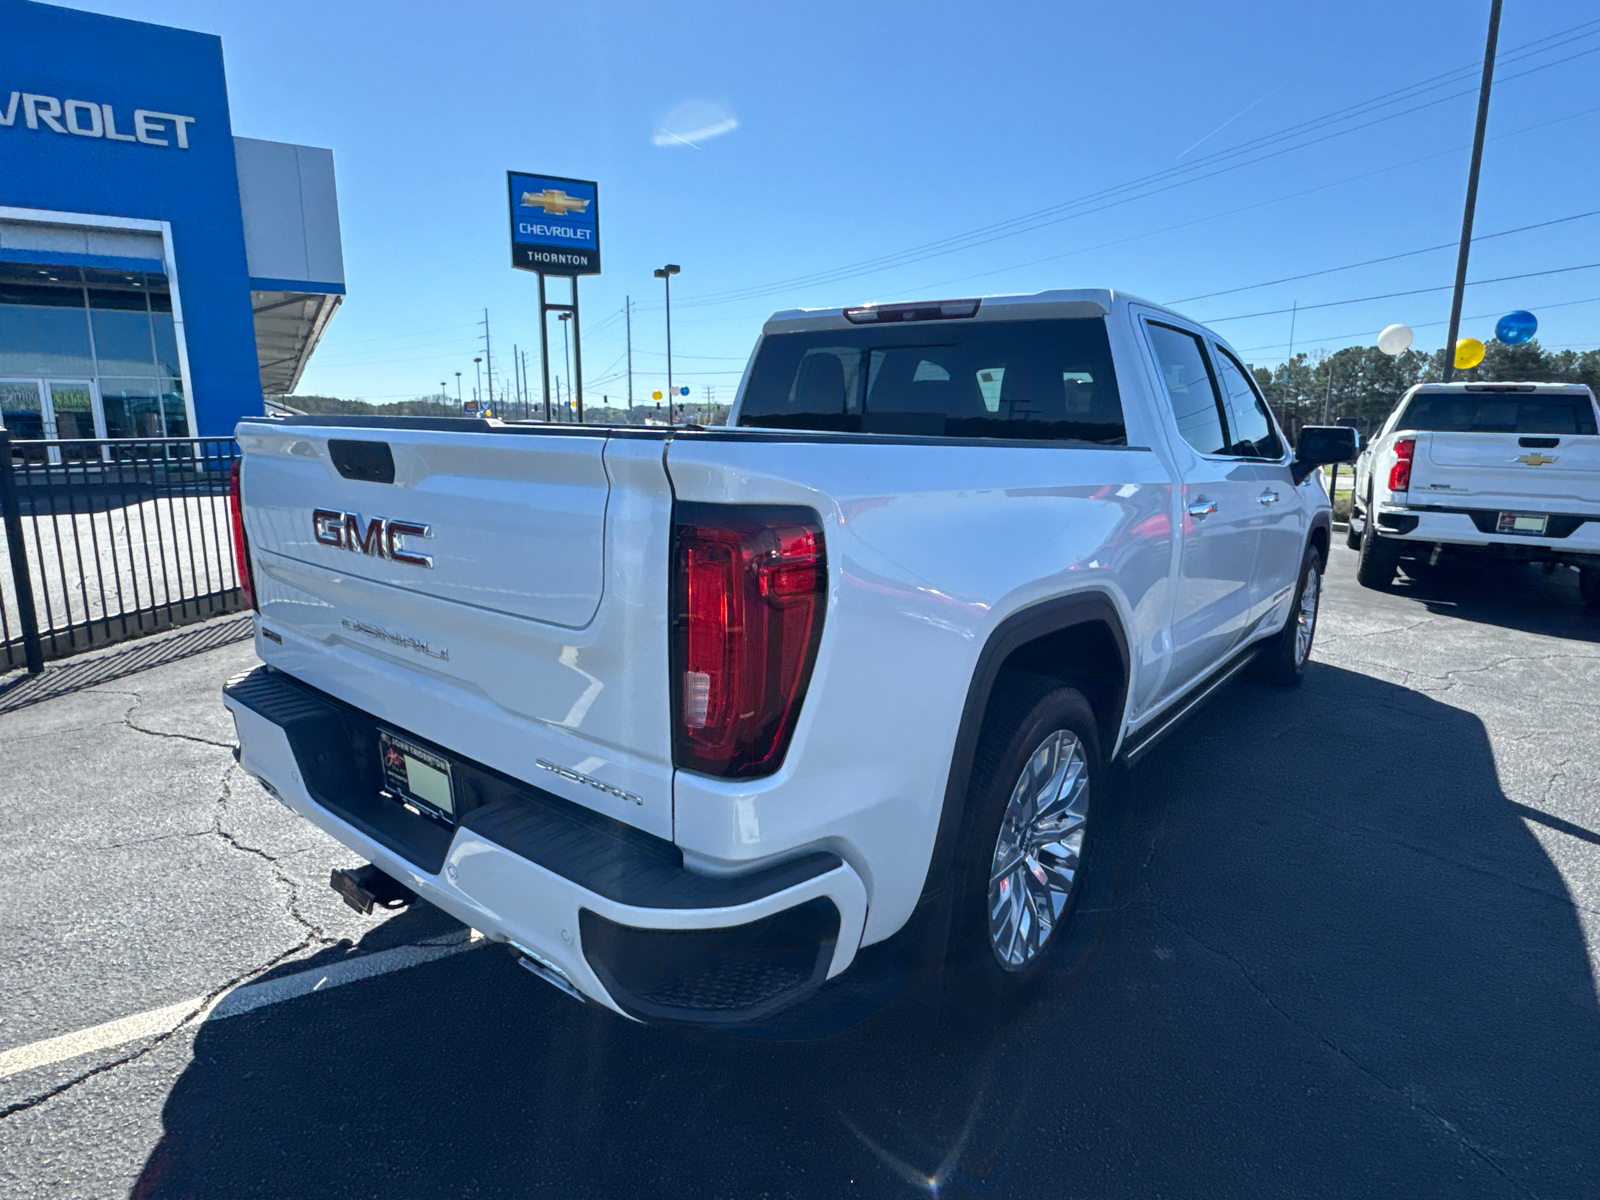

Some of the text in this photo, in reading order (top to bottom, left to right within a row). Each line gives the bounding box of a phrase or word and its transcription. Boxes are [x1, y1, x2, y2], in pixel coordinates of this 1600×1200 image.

[519, 222, 592, 239] CHEVROLET
[527, 251, 588, 265] THORNTON
[313, 507, 434, 570] GMC
[341, 615, 450, 661] DENALI
[535, 758, 643, 806] SIERRA
